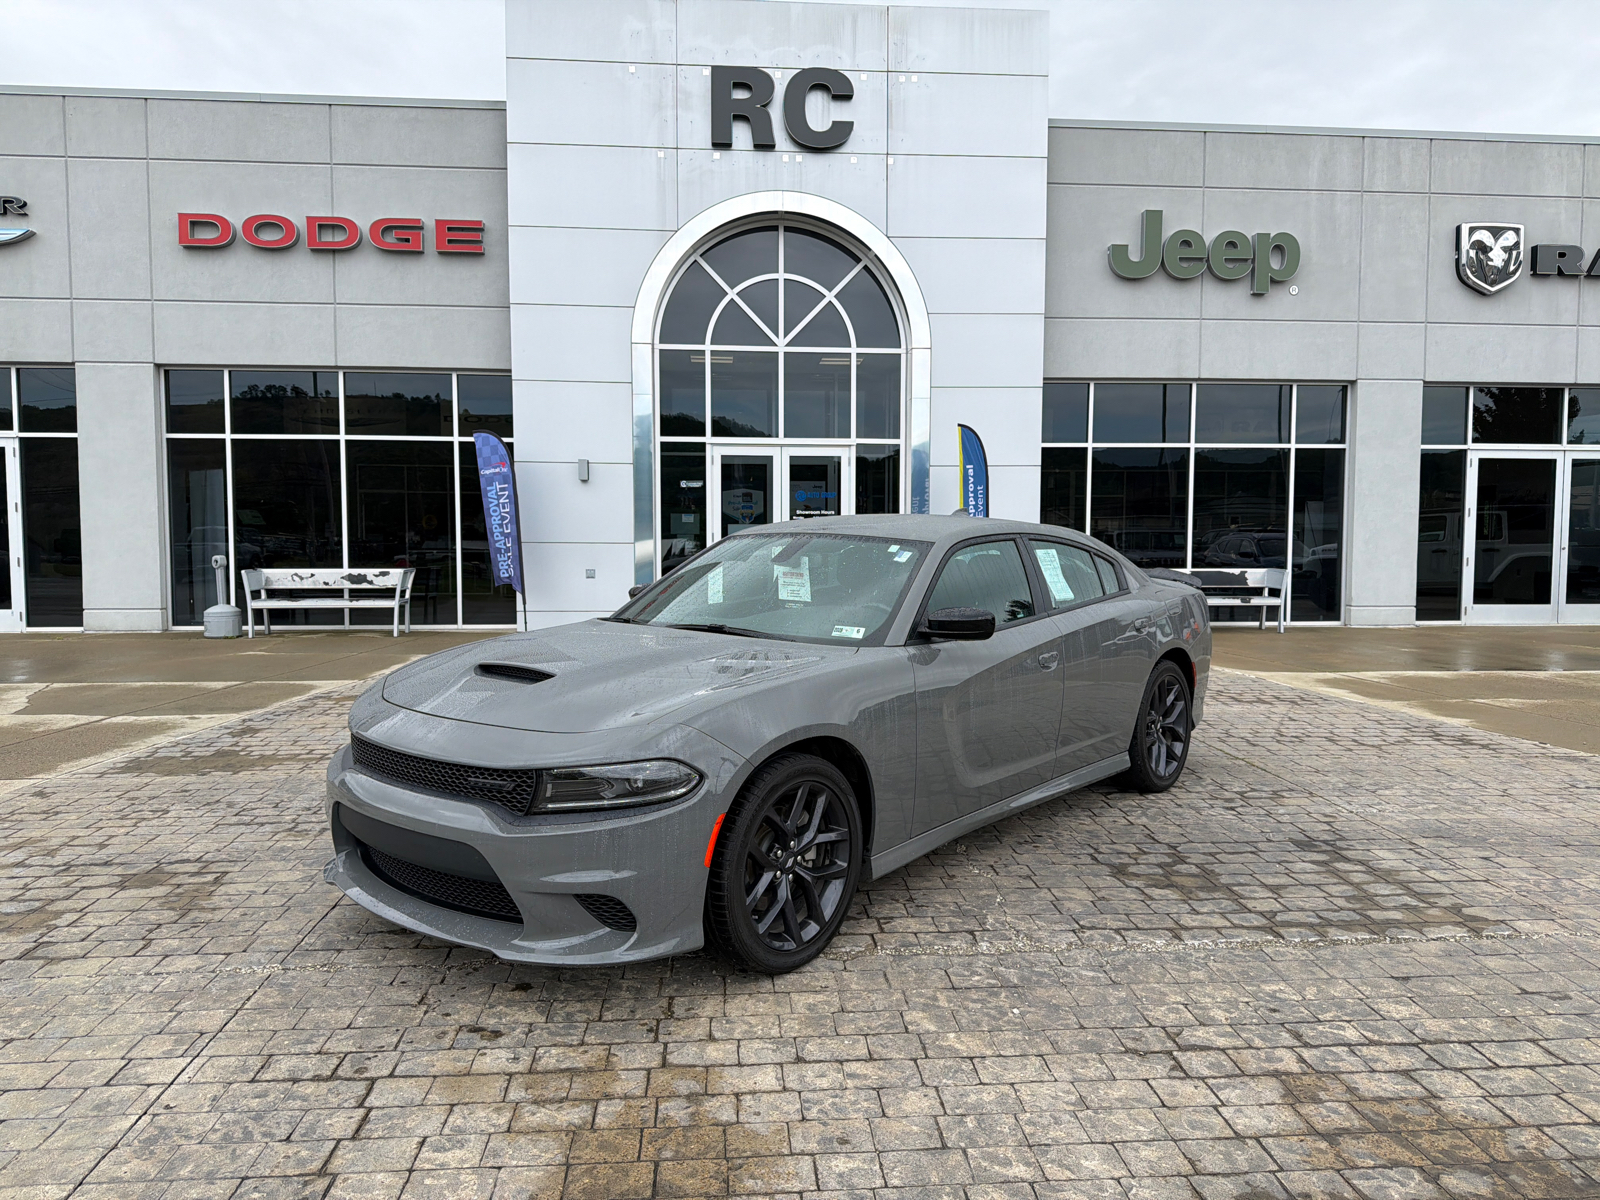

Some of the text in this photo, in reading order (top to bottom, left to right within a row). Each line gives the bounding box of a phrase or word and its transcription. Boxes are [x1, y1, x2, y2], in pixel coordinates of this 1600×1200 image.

[710, 66, 854, 151] RC
[177, 212, 485, 256] DODGE
[1107, 209, 1301, 296] Jeep
[1530, 243, 1600, 277] R
[495, 481, 511, 534] EVENT
[975, 485, 984, 518] Event
[487, 481, 509, 578] PRE-APPROVAL
